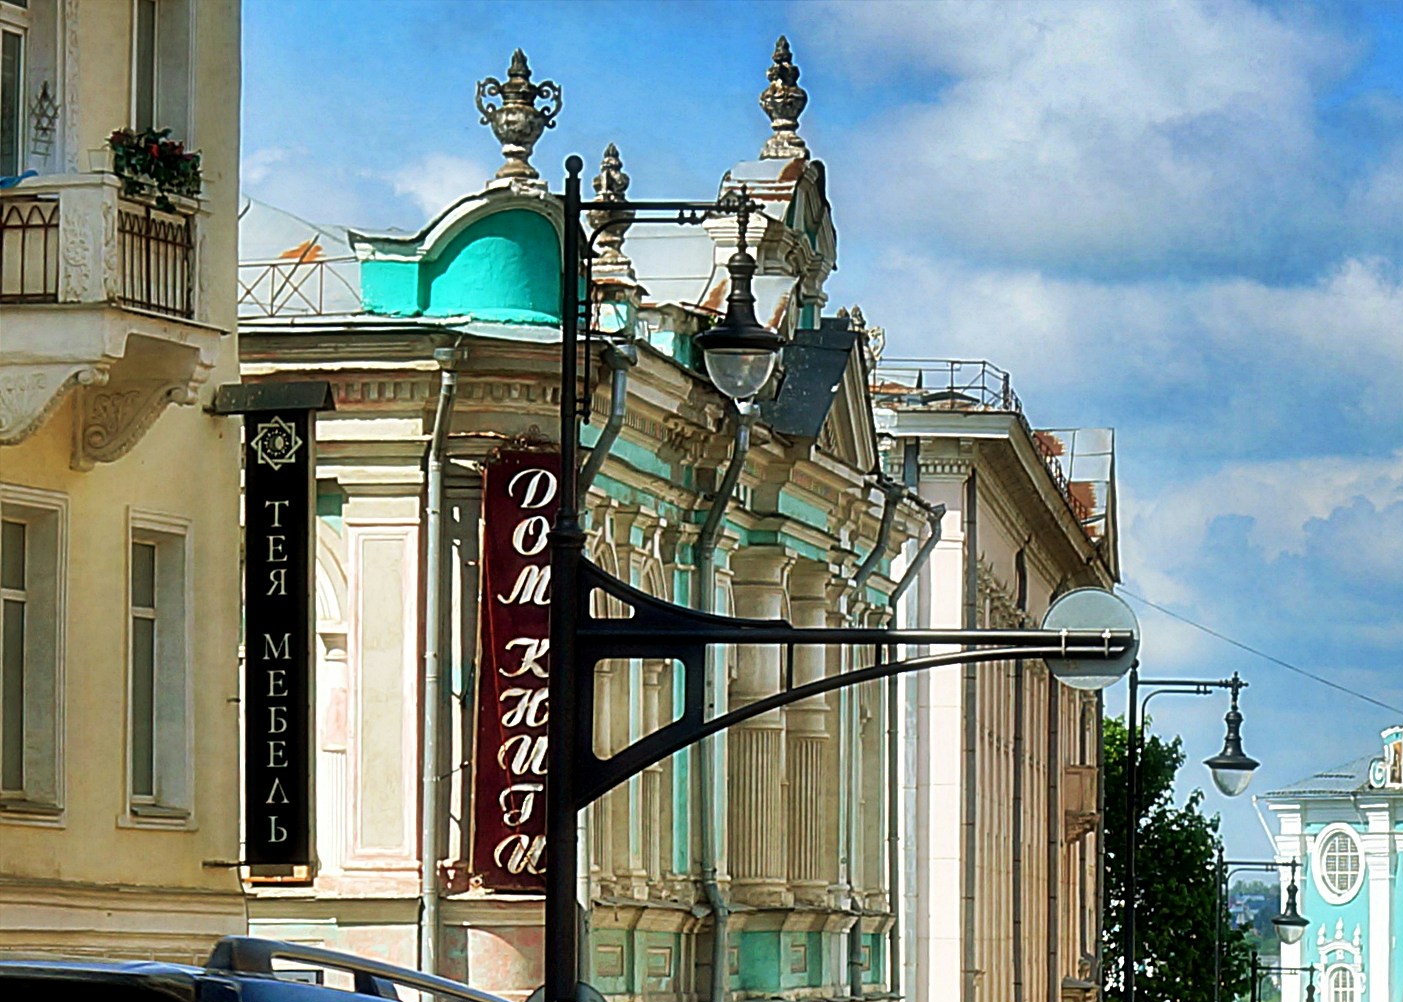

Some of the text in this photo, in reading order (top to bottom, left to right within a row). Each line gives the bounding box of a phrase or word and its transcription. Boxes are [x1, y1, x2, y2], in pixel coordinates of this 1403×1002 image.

[497, 468, 558, 606] ДОМ
[262, 500, 292, 843] ТЕЯ МЕБЕЛЬ
